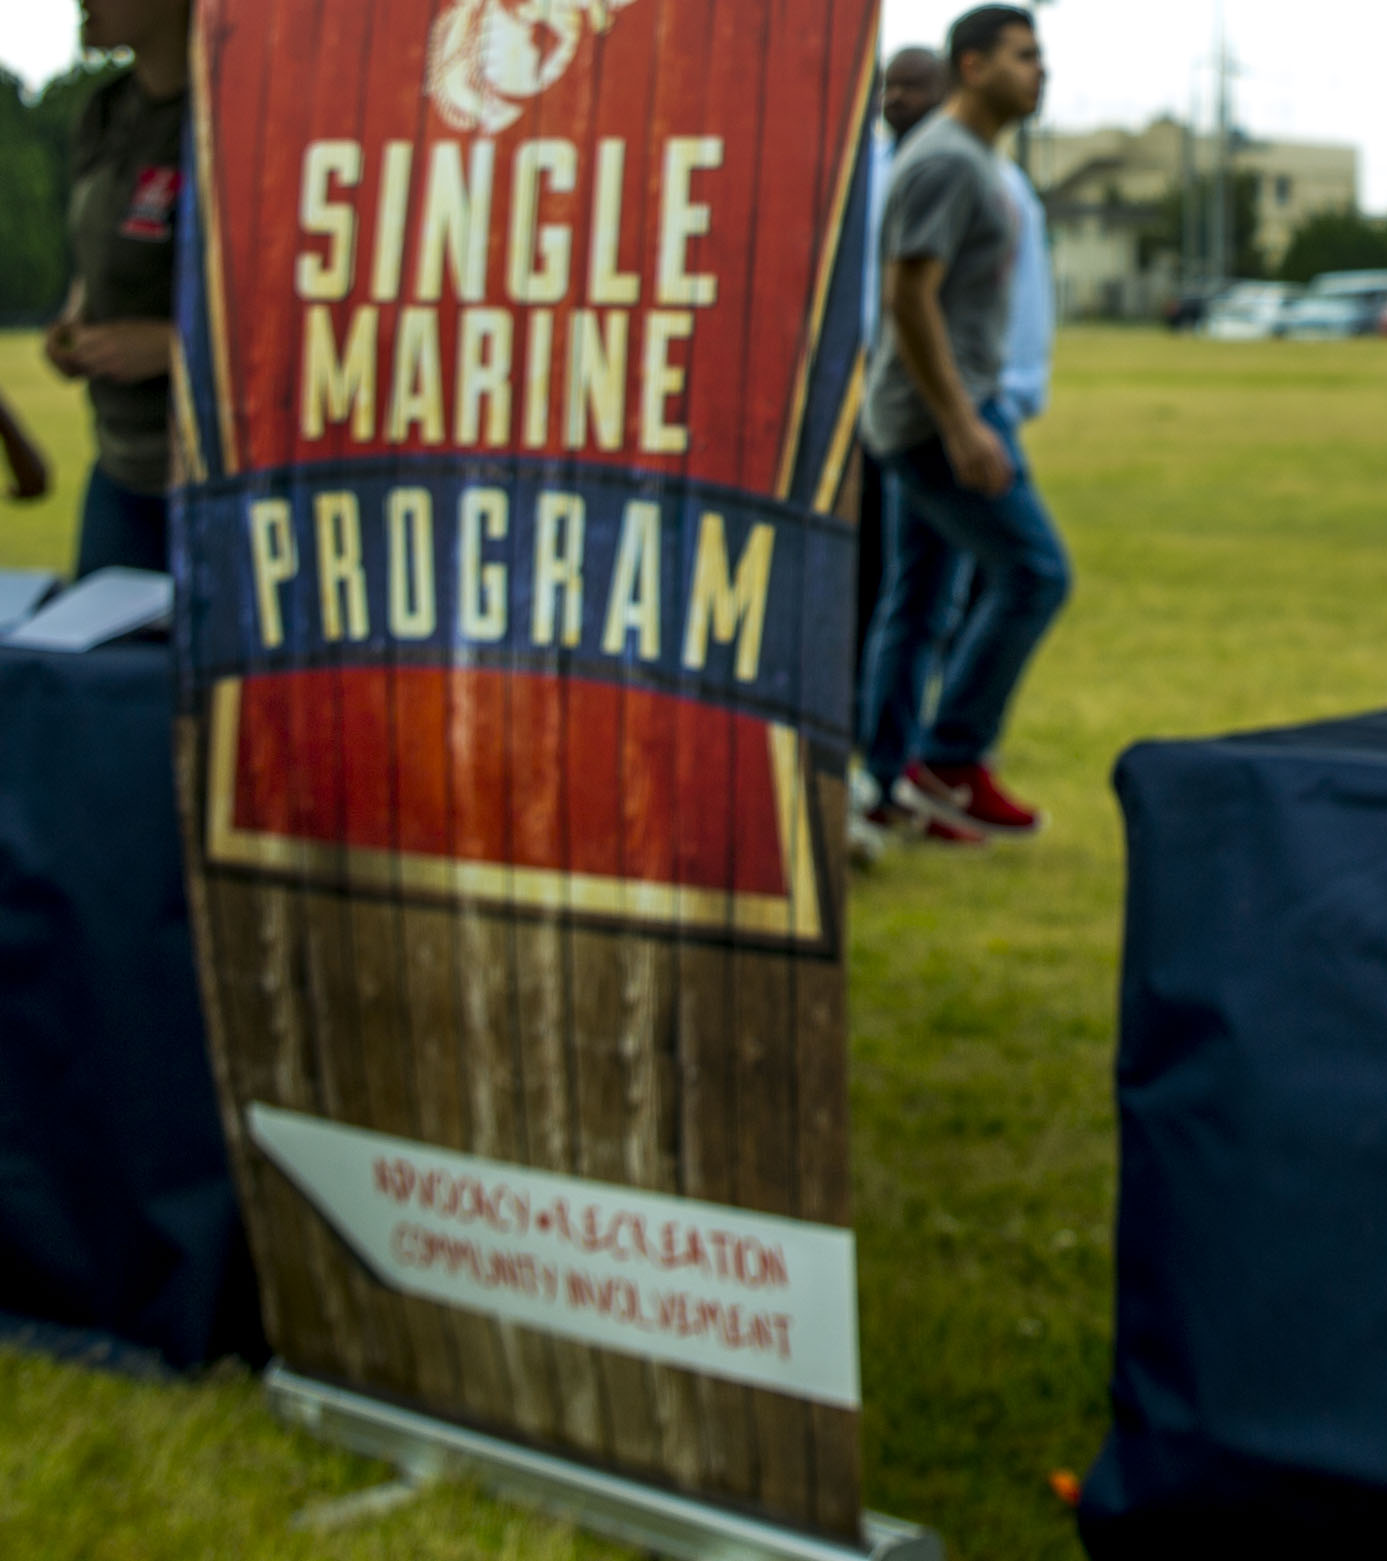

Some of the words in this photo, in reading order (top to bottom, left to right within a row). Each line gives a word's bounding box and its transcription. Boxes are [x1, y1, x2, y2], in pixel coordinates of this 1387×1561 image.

[297, 135, 724, 307] SINGLE
[302, 307, 693, 453] MARINE
[250, 487, 775, 681] PROGRAM
